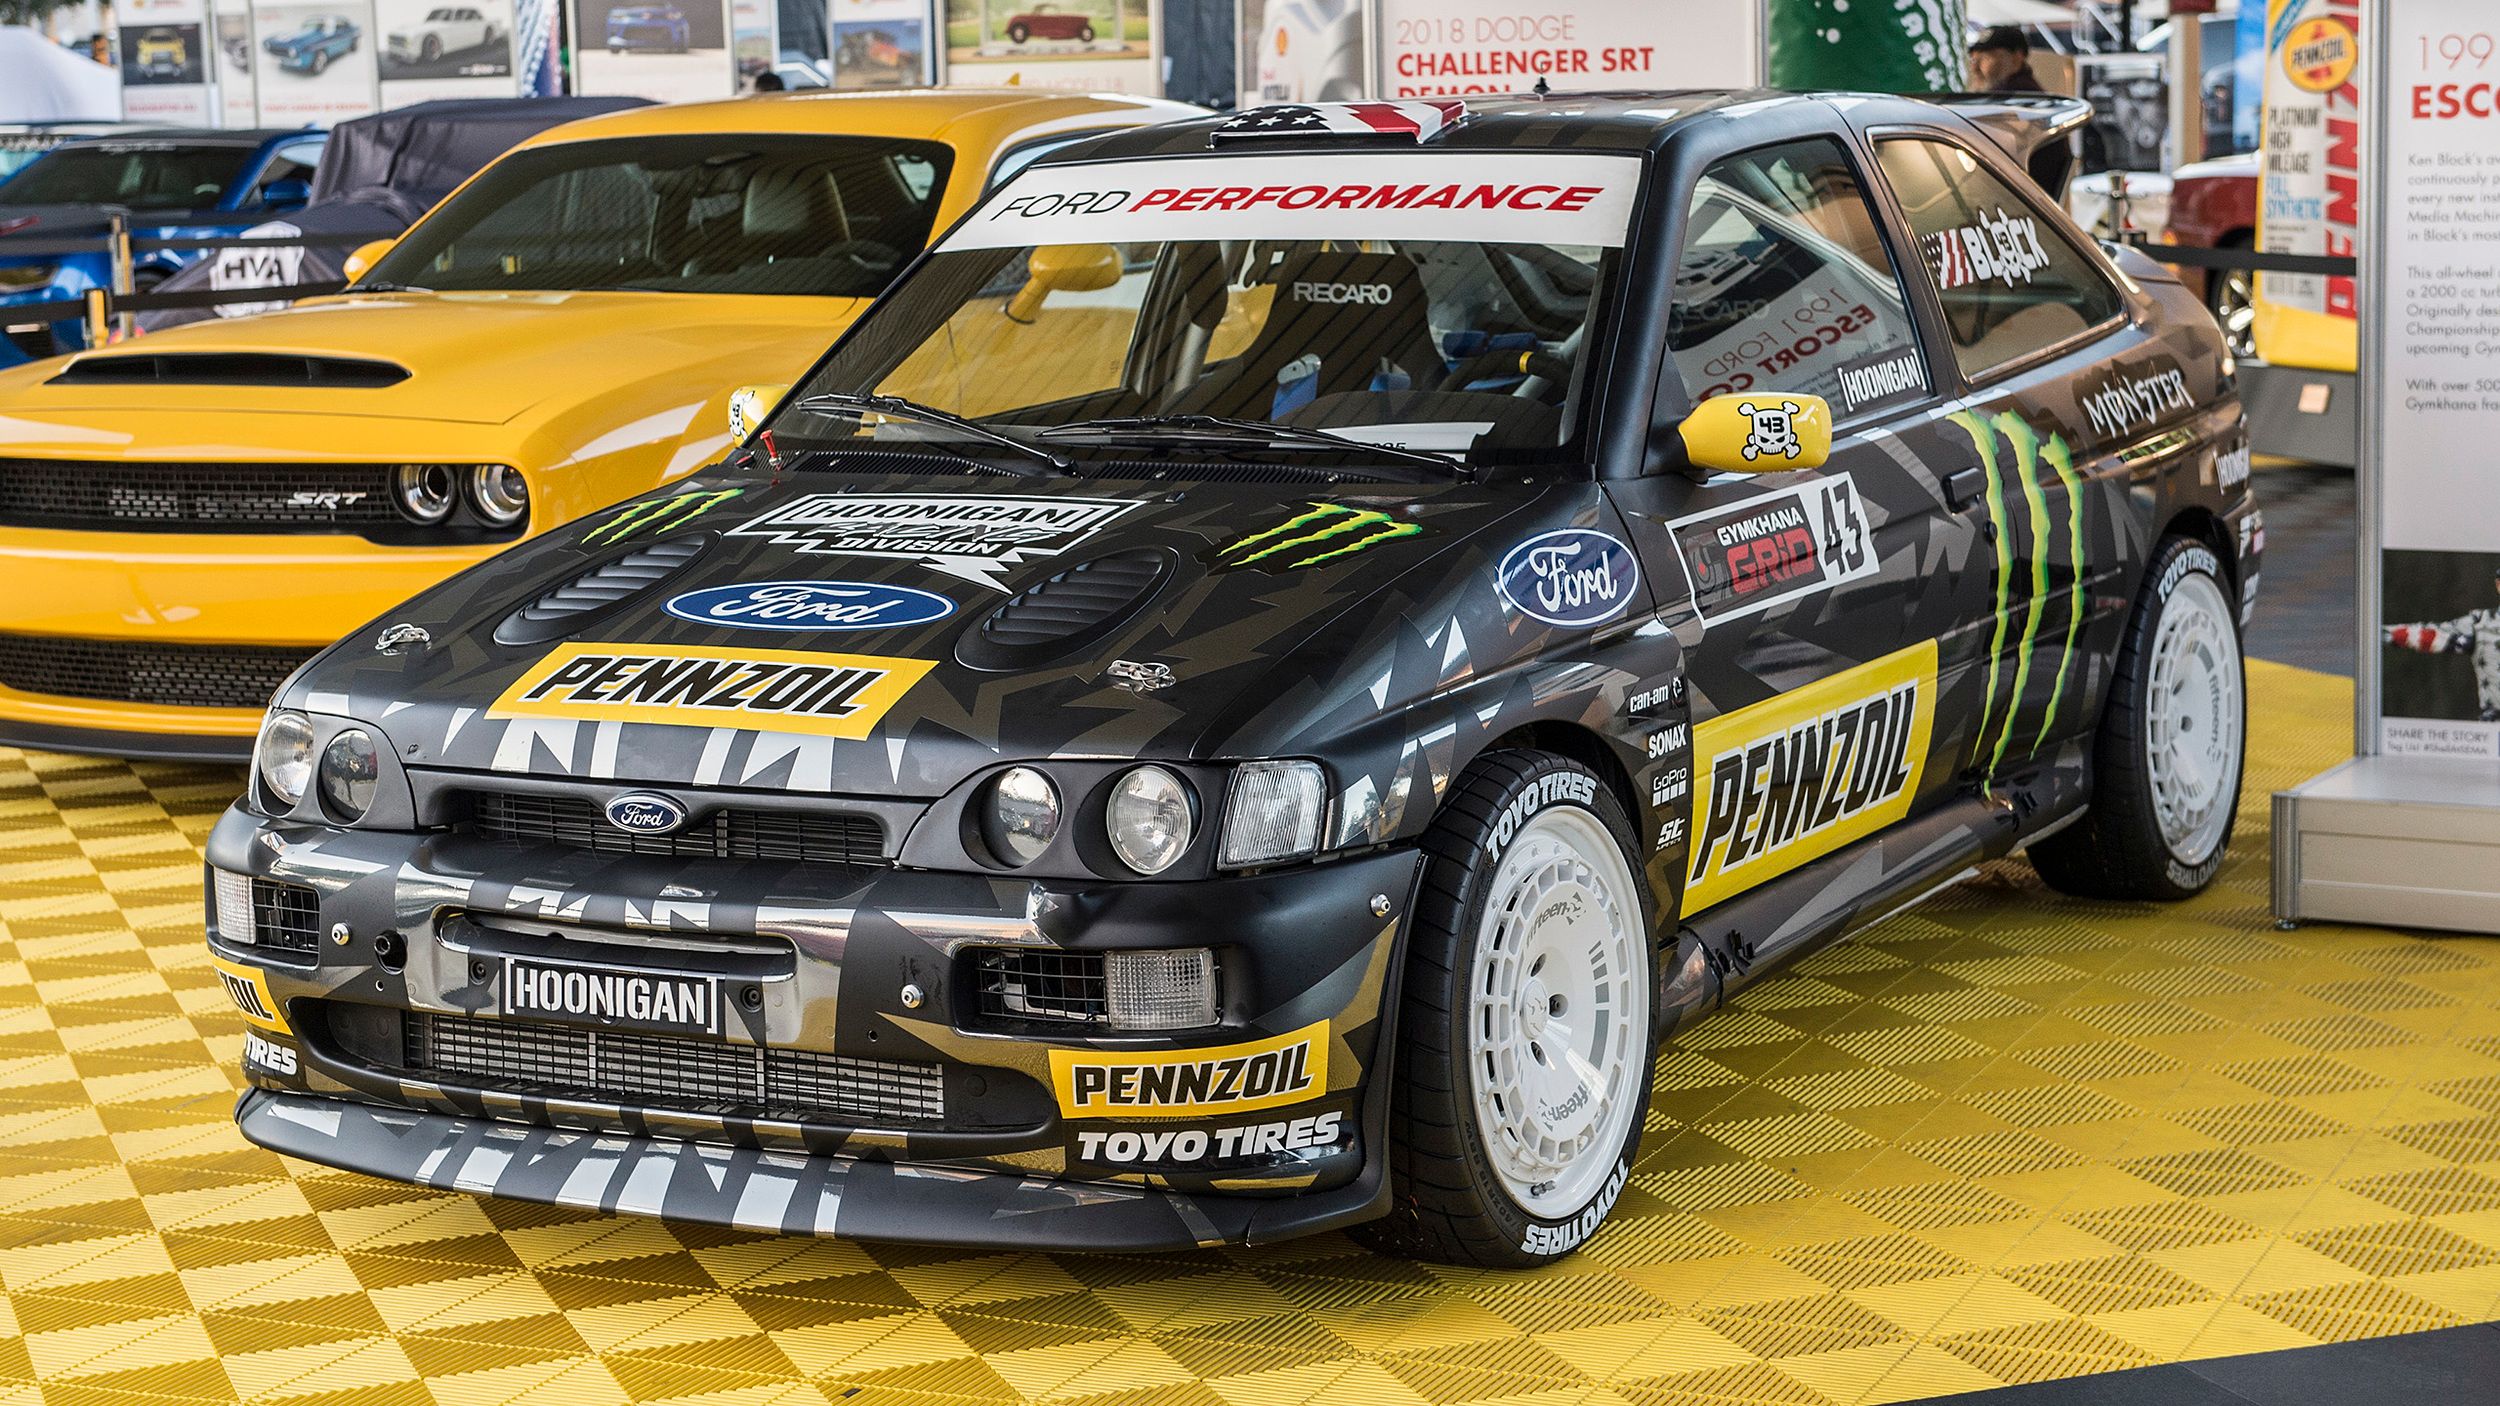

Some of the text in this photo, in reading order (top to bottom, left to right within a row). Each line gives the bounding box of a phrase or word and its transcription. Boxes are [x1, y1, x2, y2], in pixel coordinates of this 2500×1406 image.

[1397, 15, 1575, 45] 2018 DODGE
[1397, 47, 1654, 77] CHALLENGER SRT
[2411, 83, 2500, 119] ESC
[992, 184, 1605, 221] FORD PERFORMANCE
[225, 256, 285, 282] HVA
[2406, 265, 2432, 279] This
[1293, 281, 1392, 305] RECARO
[2420, 284, 2457, 299] 2000
[2406, 303, 2471, 319] Originally
[2406, 343, 2469, 357] upcoming
[2405, 379, 2436, 392] With
[2405, 396, 2477, 412] Gymkhana
[1759, 416, 1785, 434] 43
[287, 491, 367, 510] SRT
[1716, 506, 1804, 547] GYMKHANA
[1820, 479, 1865, 578] 43
[831, 537, 1003, 555] DIVISION
[1530, 542, 1618, 614] Ford
[709, 583, 905, 624] Ford
[523, 653, 892, 719] PENNZOIL
[1629, 684, 1669, 713] can-am
[1648, 722, 1688, 760] SONAX
[1653, 766, 1688, 792] GoPro
[1686, 678, 1920, 891] PENNZOIL
[620, 799, 667, 831] Ford
[1486, 771, 1597, 864] TOYO TIRES
[1073, 1038, 1317, 1108] PENNZOIL
[1078, 1110, 1344, 1162] TOYO TIRES
[1520, 1156, 1630, 1256] TOYO TIRES
